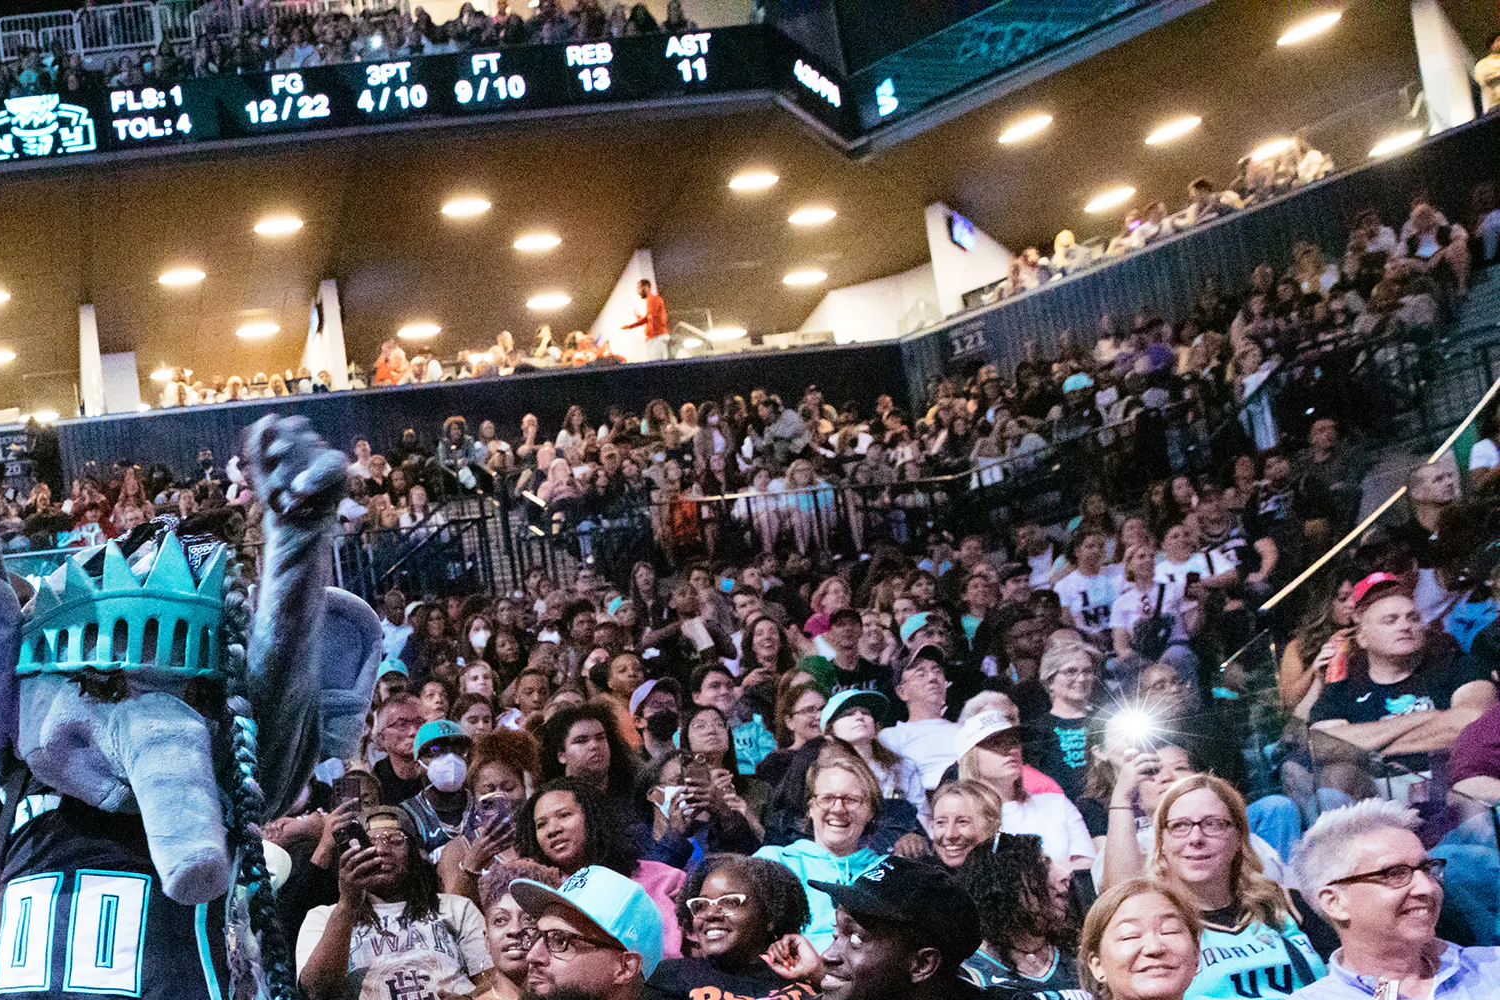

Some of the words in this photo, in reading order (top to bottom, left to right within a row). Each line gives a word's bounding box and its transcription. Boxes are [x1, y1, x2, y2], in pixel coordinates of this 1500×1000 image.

[566, 42, 613, 66] REB
[665, 32, 712, 58] AST
[366, 61, 411, 86] 3PT
[471, 52, 501, 75] FT
[677, 57, 708, 82] 11
[271, 73, 304, 95] FG
[578, 67, 611, 92] 13
[110, 88, 166, 113] FLS:
[169, 85, 183, 106] 1
[112, 117, 173, 141] TOL:
[176, 113, 192, 135] 4
